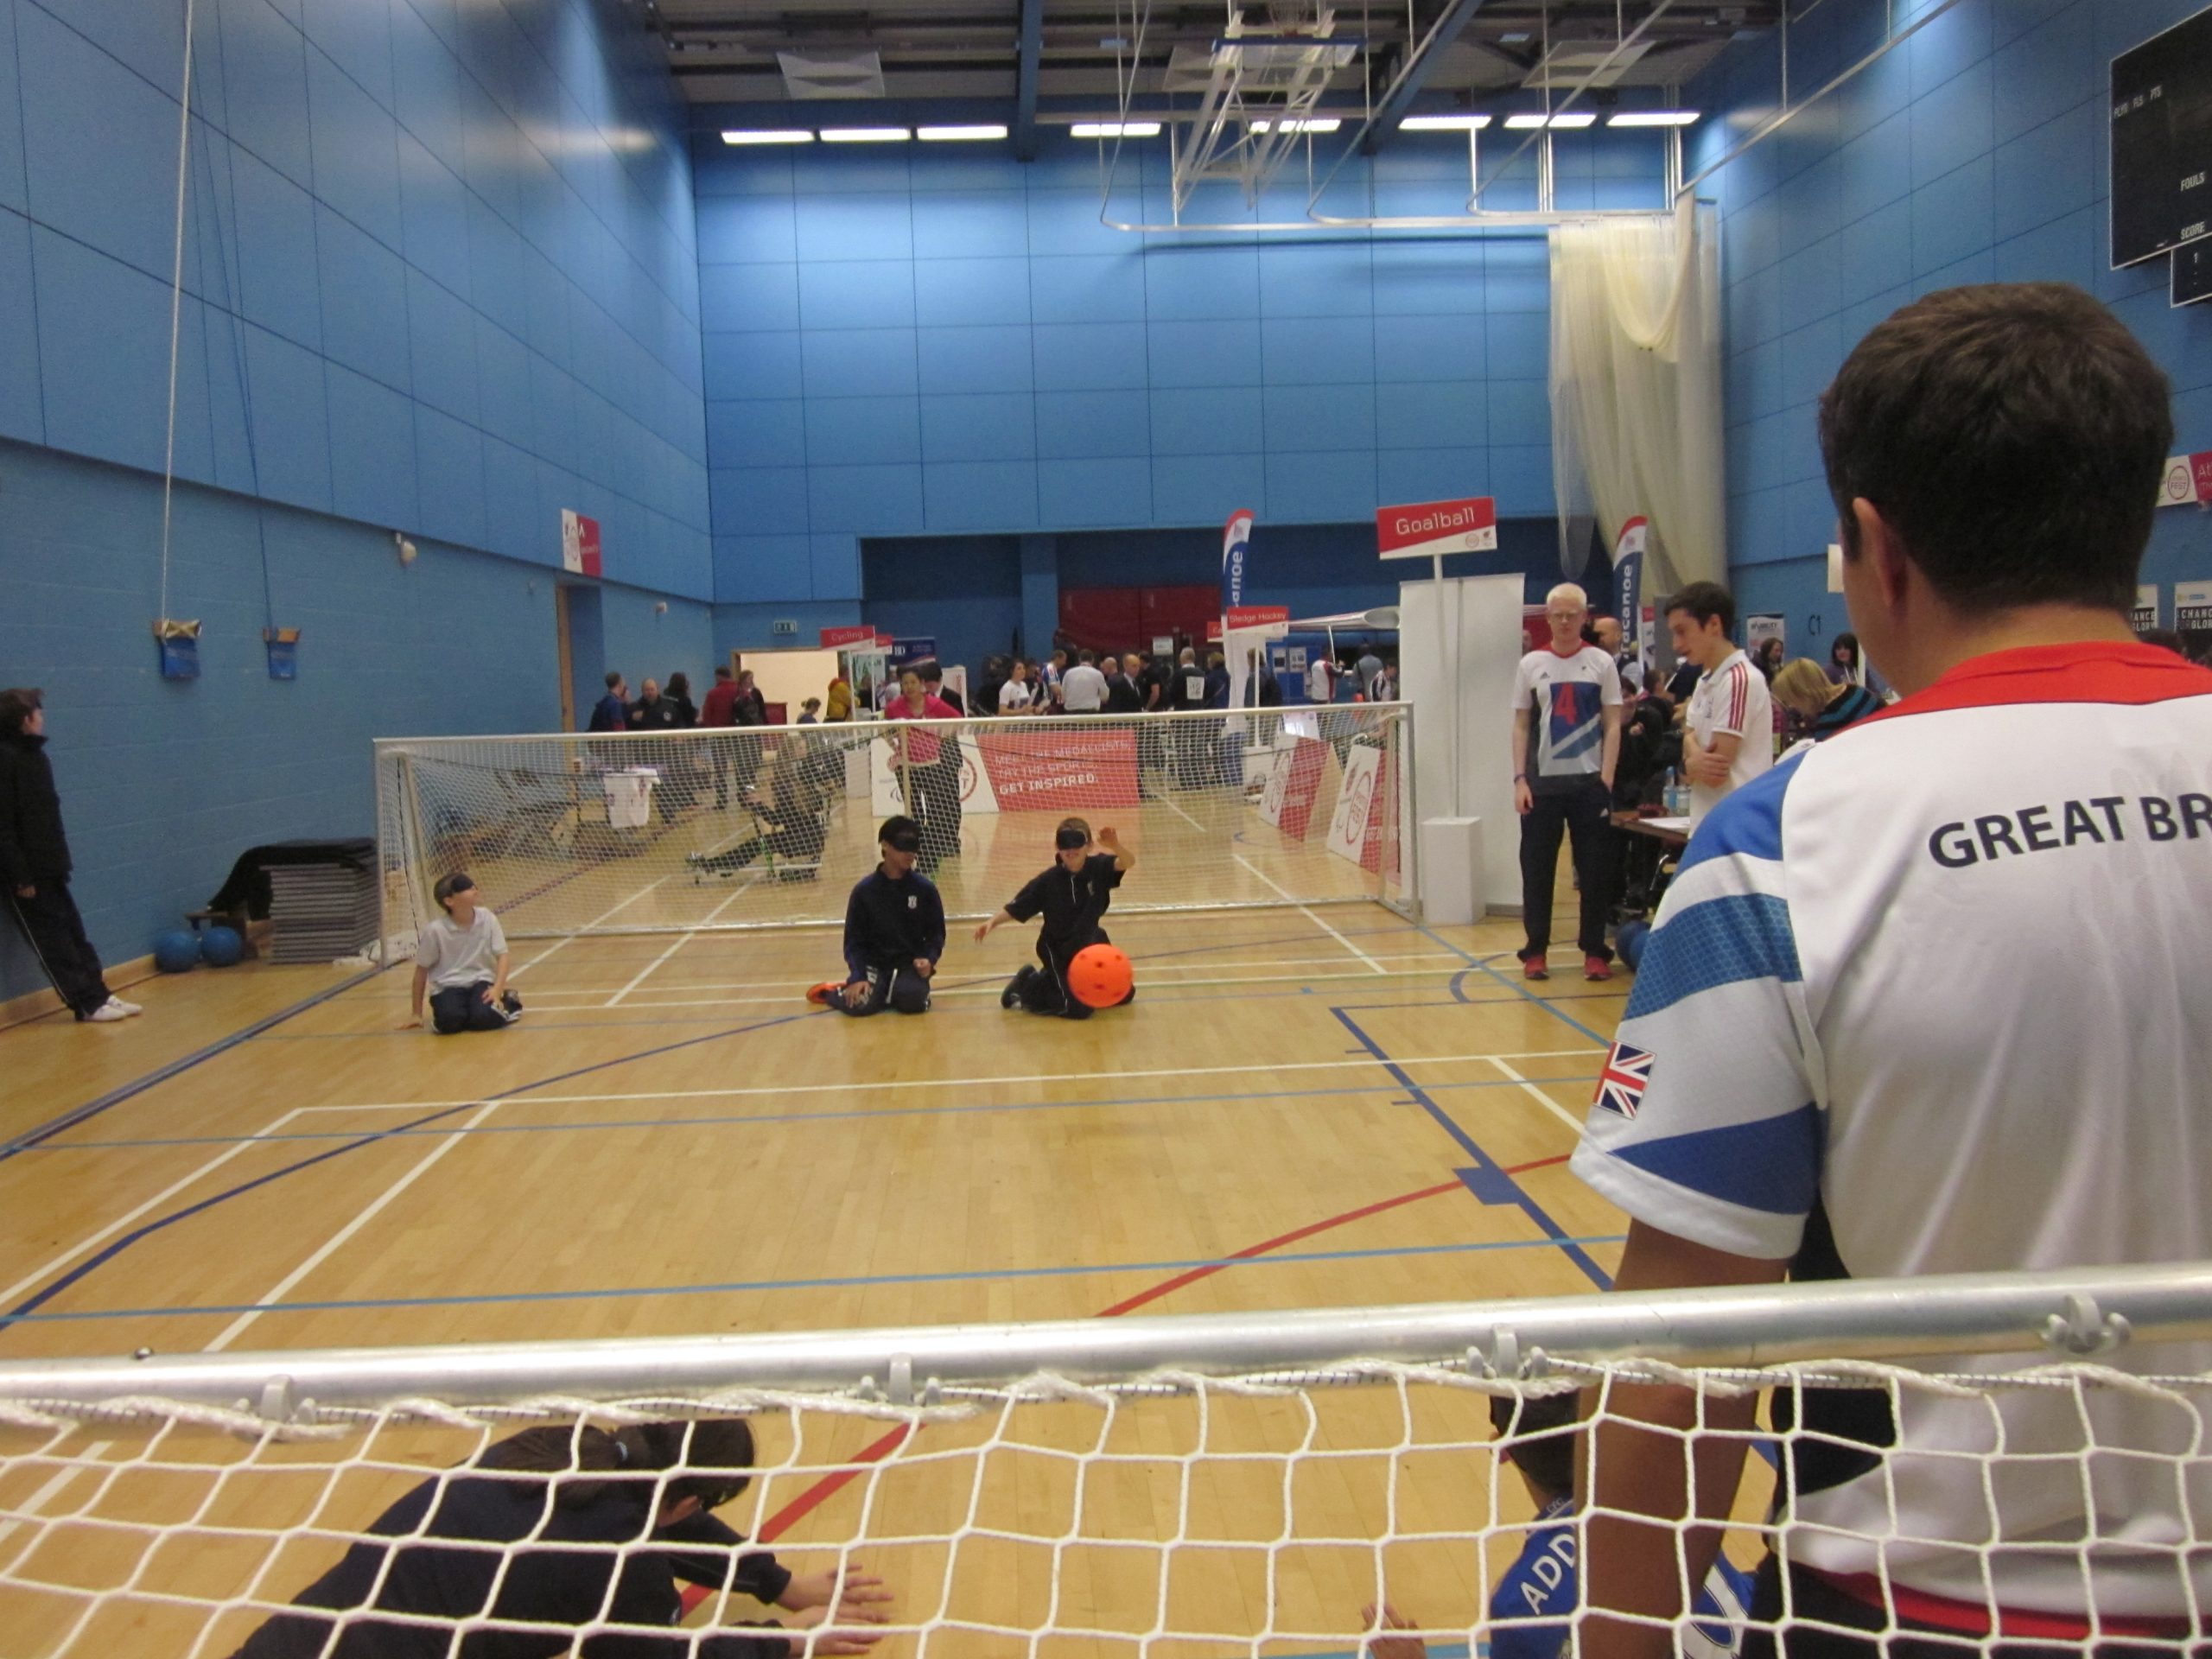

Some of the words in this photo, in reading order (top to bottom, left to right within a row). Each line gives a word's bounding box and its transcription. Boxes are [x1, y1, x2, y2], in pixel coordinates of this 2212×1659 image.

[2181, 171, 2205, 192] FOULS
[2181, 221, 2205, 240] SCORE
[1395, 506, 1474, 536] Goalball
[1232, 550, 1243, 607] anoe
[1230, 612, 1255, 623] Sledge
[1258, 611, 1287, 620] Hockey
[1808, 613, 1821, 637] C1
[830, 630, 864, 643] Cycling
[999, 781, 1025, 796] GET
[1928, 796, 2126, 868] GREAT
[2139, 791, 2212, 842] BR
[1520, 1533, 1576, 1615] ADD
